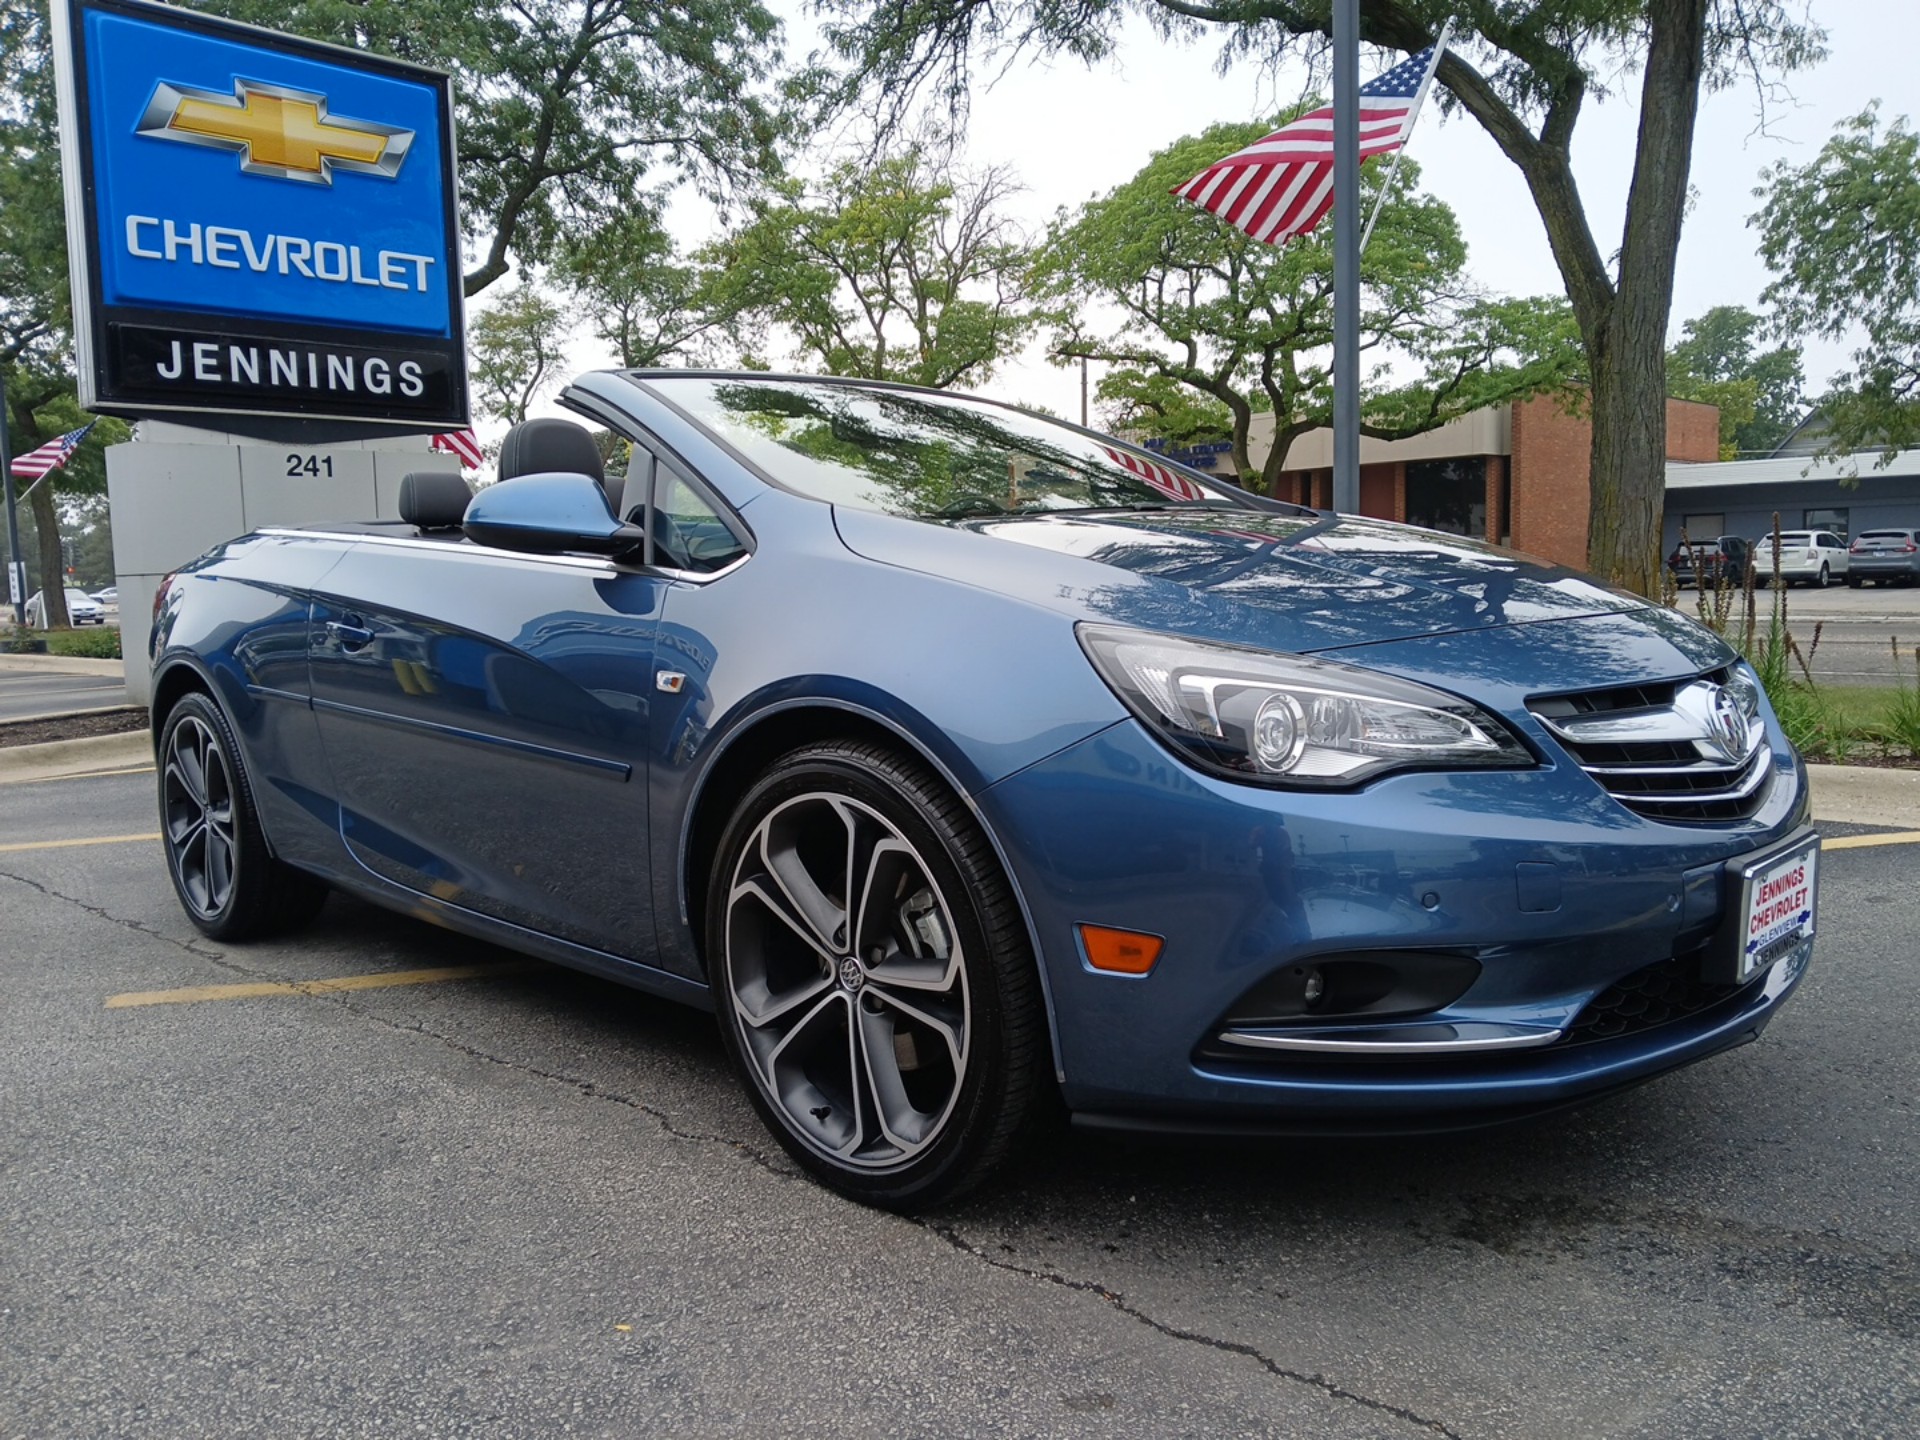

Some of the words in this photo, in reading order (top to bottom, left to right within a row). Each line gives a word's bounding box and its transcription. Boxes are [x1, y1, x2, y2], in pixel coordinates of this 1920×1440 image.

[125, 214, 435, 292] CHEVROLET
[157, 340, 425, 397] JENNINGS
[286, 454, 334, 478] 241
[1755, 865, 1805, 907] JENNINGS
[1750, 887, 1808, 935] CHEVROLET
[1759, 914, 1799, 946] GLENVIEW
